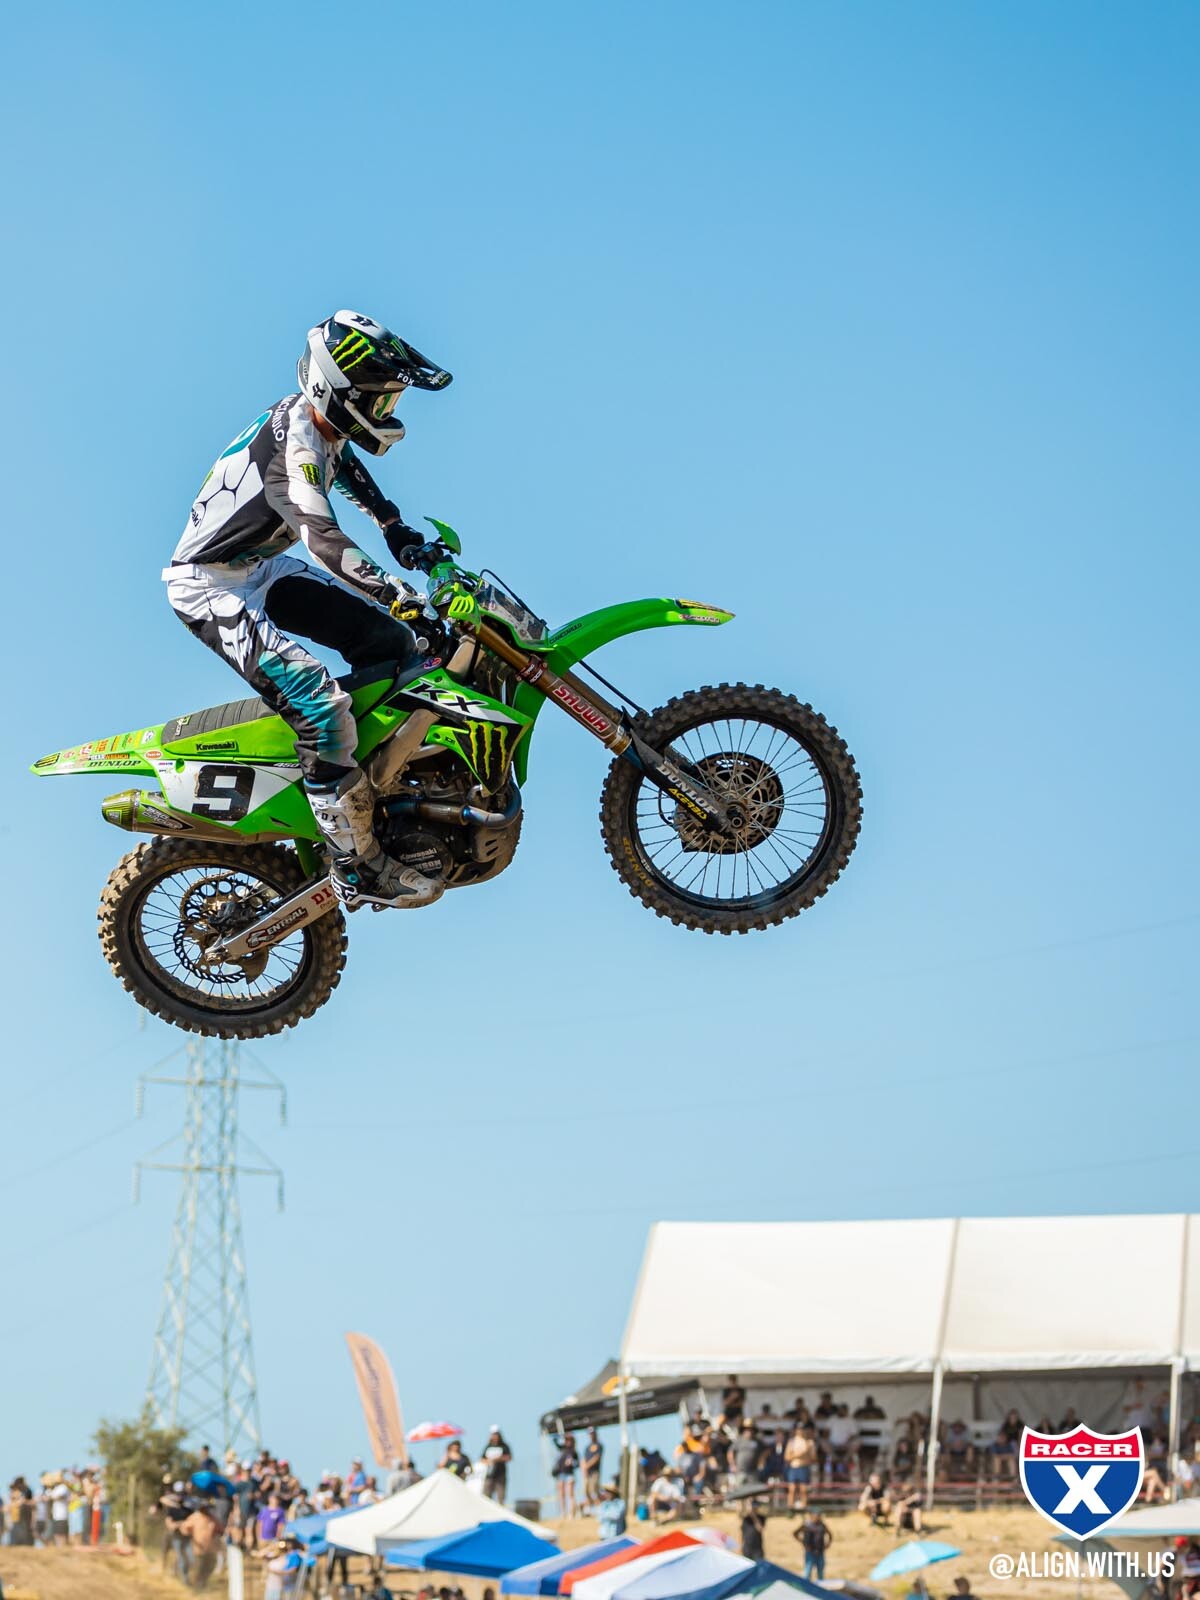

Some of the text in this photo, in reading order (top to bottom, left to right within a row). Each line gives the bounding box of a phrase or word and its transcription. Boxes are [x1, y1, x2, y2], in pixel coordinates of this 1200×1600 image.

[396, 372, 415, 386] FOX
[408, 682, 487, 713] KX
[552, 684, 610, 732] SHOWA
[196, 741, 235, 751] Kawasaki
[88, 760, 141, 769] DUNLOP
[191, 764, 256, 821] 9
[656, 763, 718, 814] DUNLOP
[668, 787, 707, 820] ACERBIS
[311, 884, 334, 905] DI
